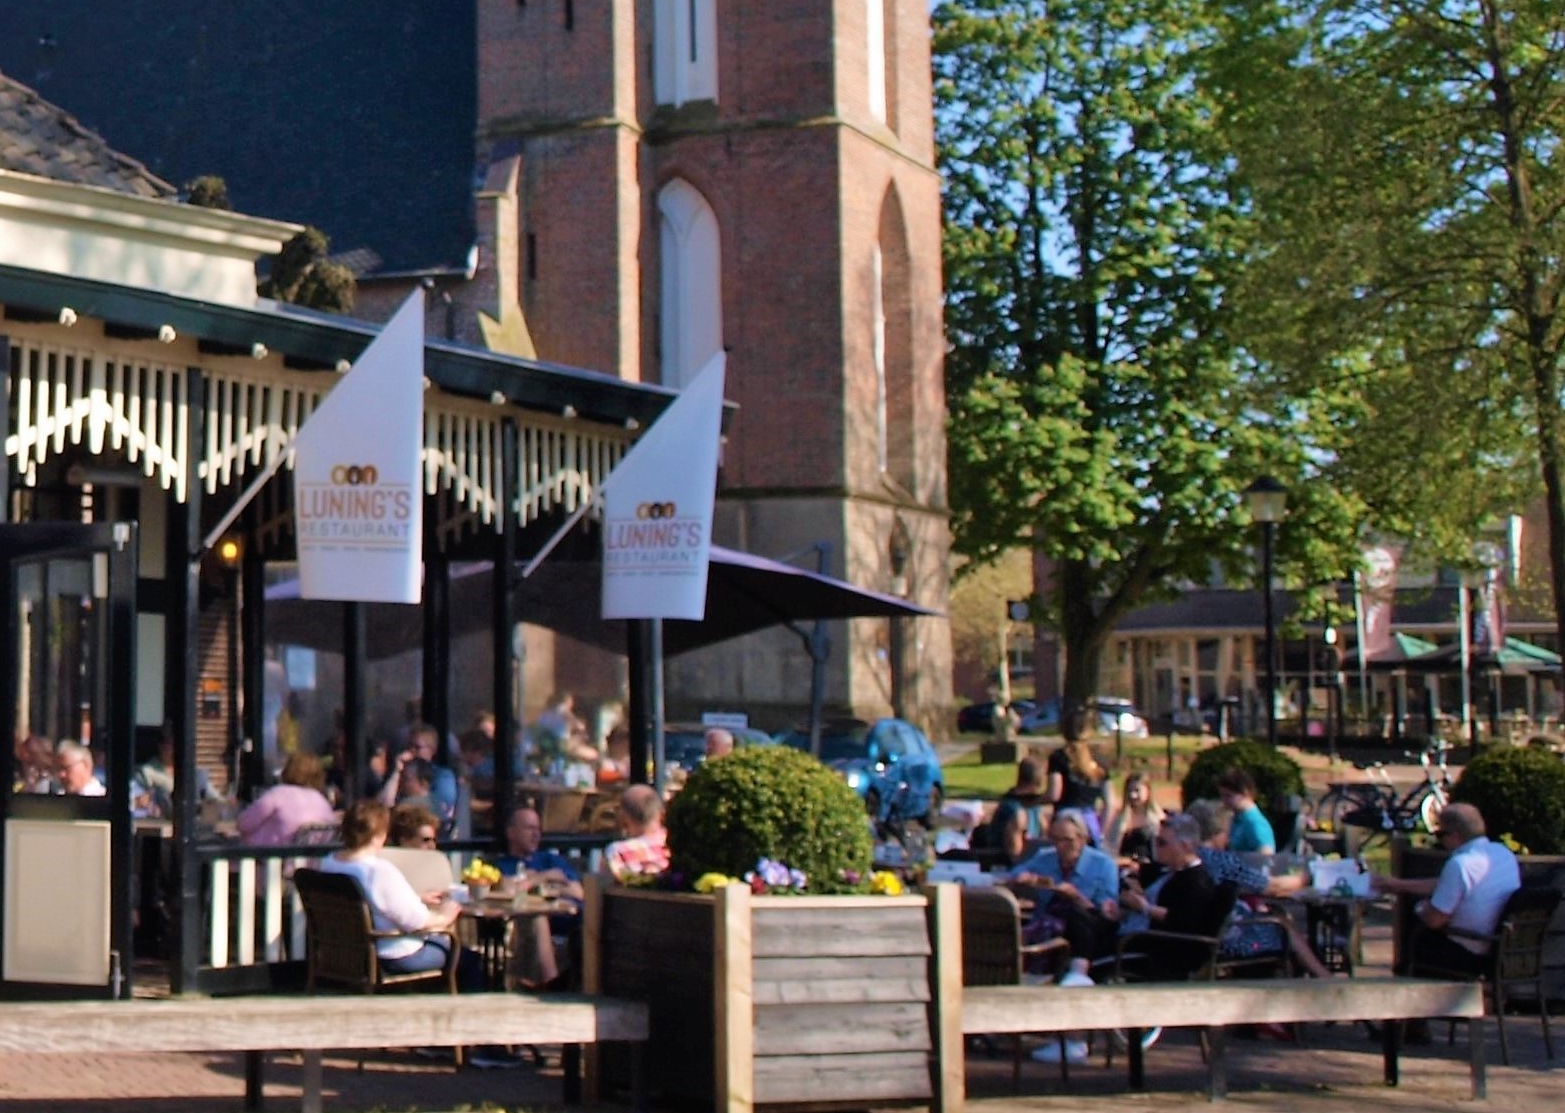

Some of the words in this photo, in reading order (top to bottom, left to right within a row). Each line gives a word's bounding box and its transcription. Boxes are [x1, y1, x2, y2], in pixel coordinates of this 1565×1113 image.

[300, 490, 409, 520] LUNING'S
[300, 522, 408, 537] RESTAURANT
[607, 522, 701, 549] LUNING'S
[606, 550, 699, 564] RESTAURANT
